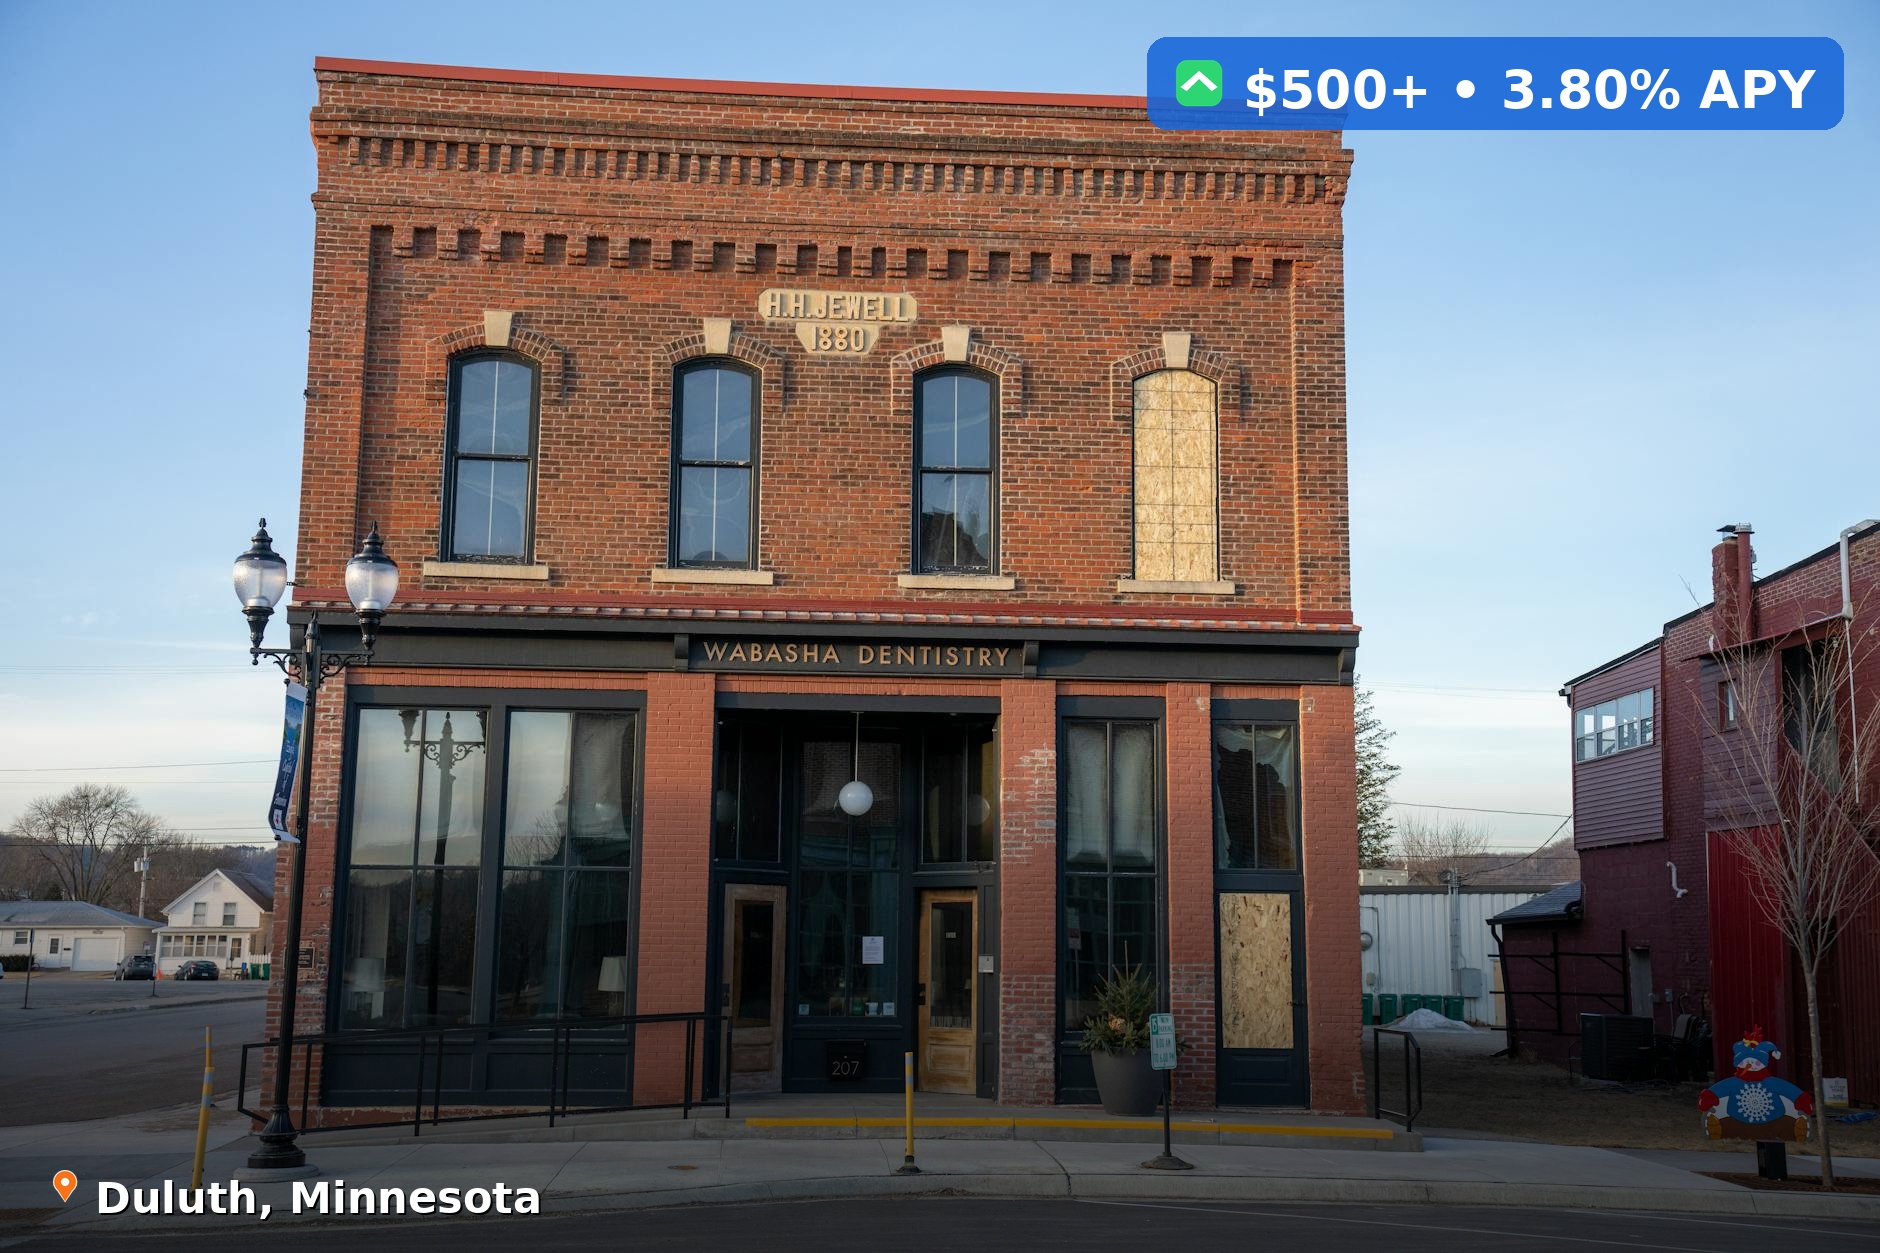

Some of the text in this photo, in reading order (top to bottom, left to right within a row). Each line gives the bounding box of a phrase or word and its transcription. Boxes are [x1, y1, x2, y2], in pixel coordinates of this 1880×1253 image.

[811, 325, 865, 352] 1880
[703, 641, 1010, 667] WABASHA DENTISTRY
[831, 1060, 860, 1076] 207
